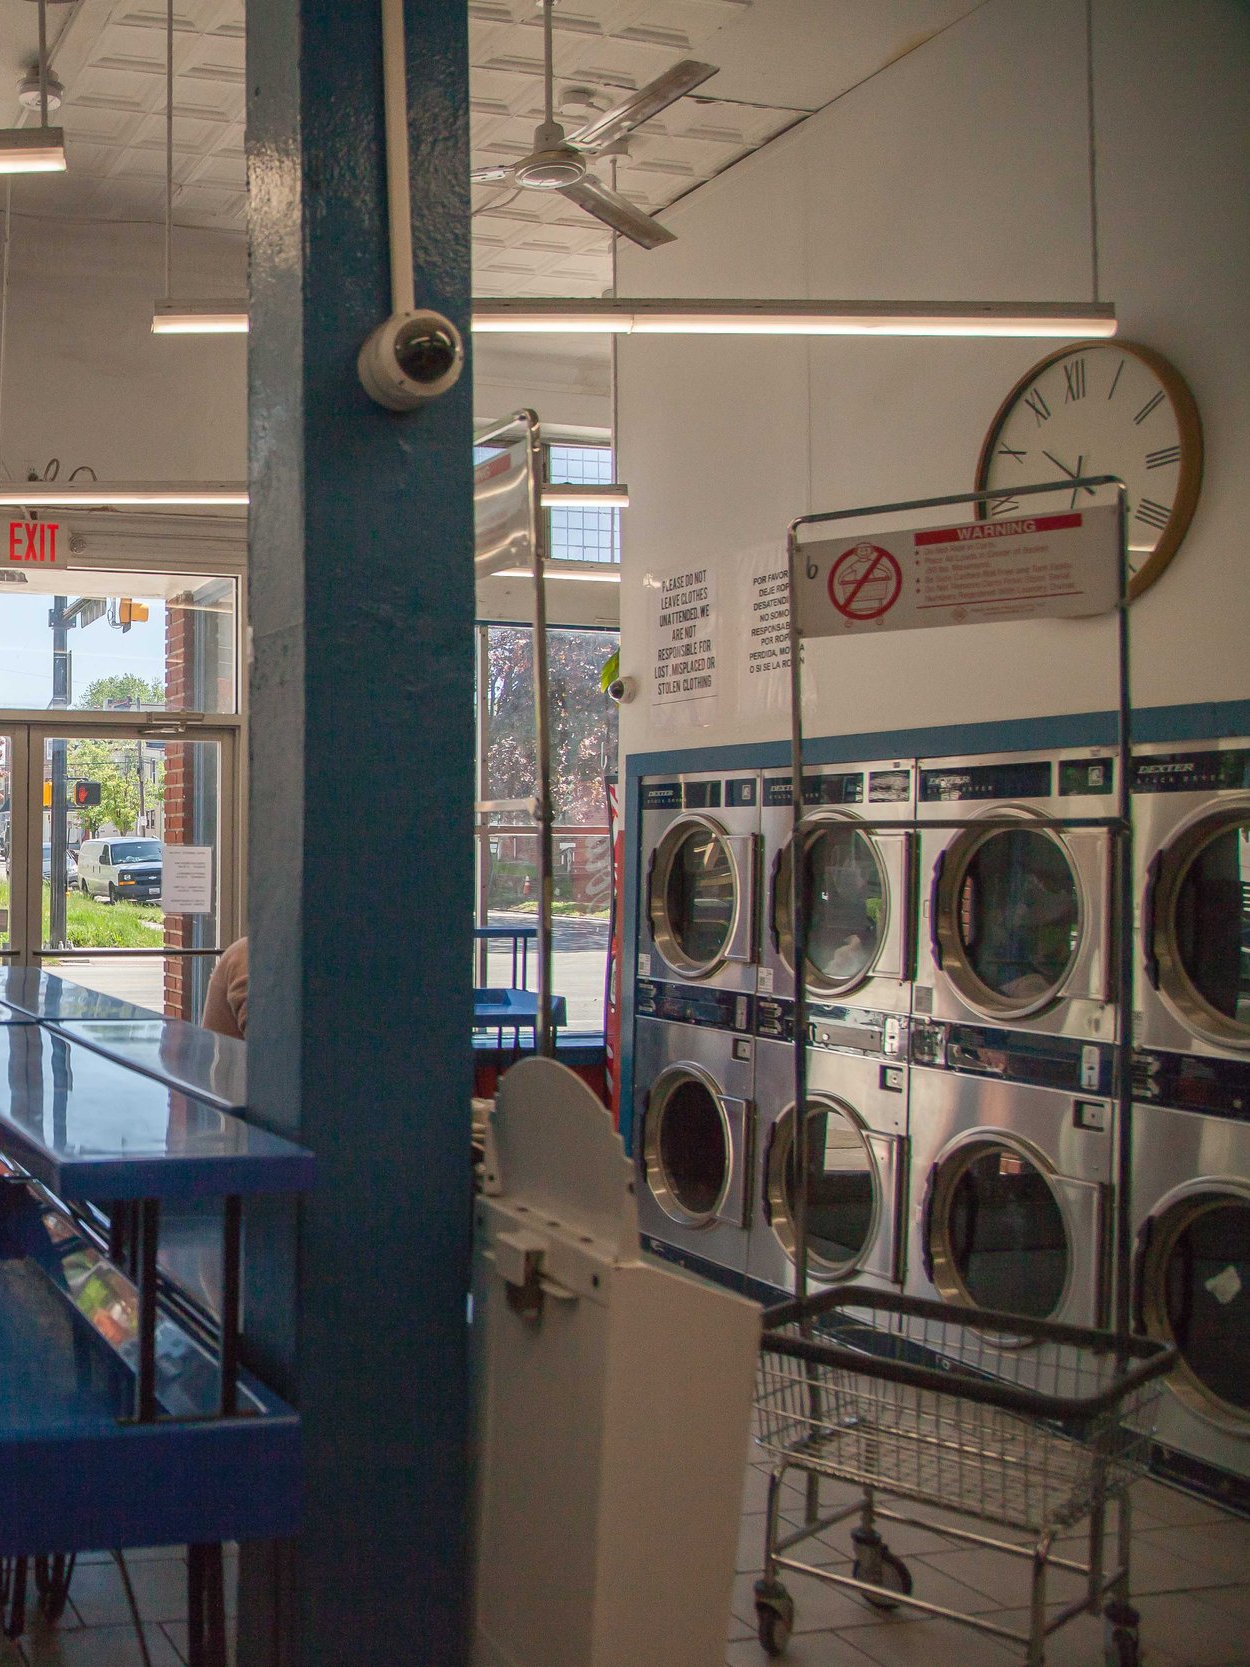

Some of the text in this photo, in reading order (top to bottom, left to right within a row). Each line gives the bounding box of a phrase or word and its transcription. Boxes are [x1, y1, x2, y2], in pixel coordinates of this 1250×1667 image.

[956, 520, 1037, 541] WARNING
[9, 522, 59, 562] EXIT
[662, 569, 707, 593] PLEASE DO NOT
[753, 575, 767, 585] POR
[759, 583, 790, 597] DEJE ROP
[661, 587, 708, 610] LEAVE CLOTHES
[753, 596, 790, 611] DESATENDI
[700, 604, 710, 618] WE
[760, 609, 790, 622] NO SOMO
[672, 625, 696, 641] ARE NOT
[751, 622, 790, 636] RESPONSAB
[761, 633, 790, 646] POR ROP
[657, 639, 711, 661] RESPONSIBLE FOR
[706, 656, 716, 670] OR
[750, 665, 755, 674] O
[756, 664, 762, 672] SI
[763, 662, 771, 672] SE
[772, 661, 780, 670] LA
[658, 675, 711, 695] STOLEN CLOTHING
[1137, 763, 1196, 774] DEXTER
[648, 789, 674, 797] DEXTER
